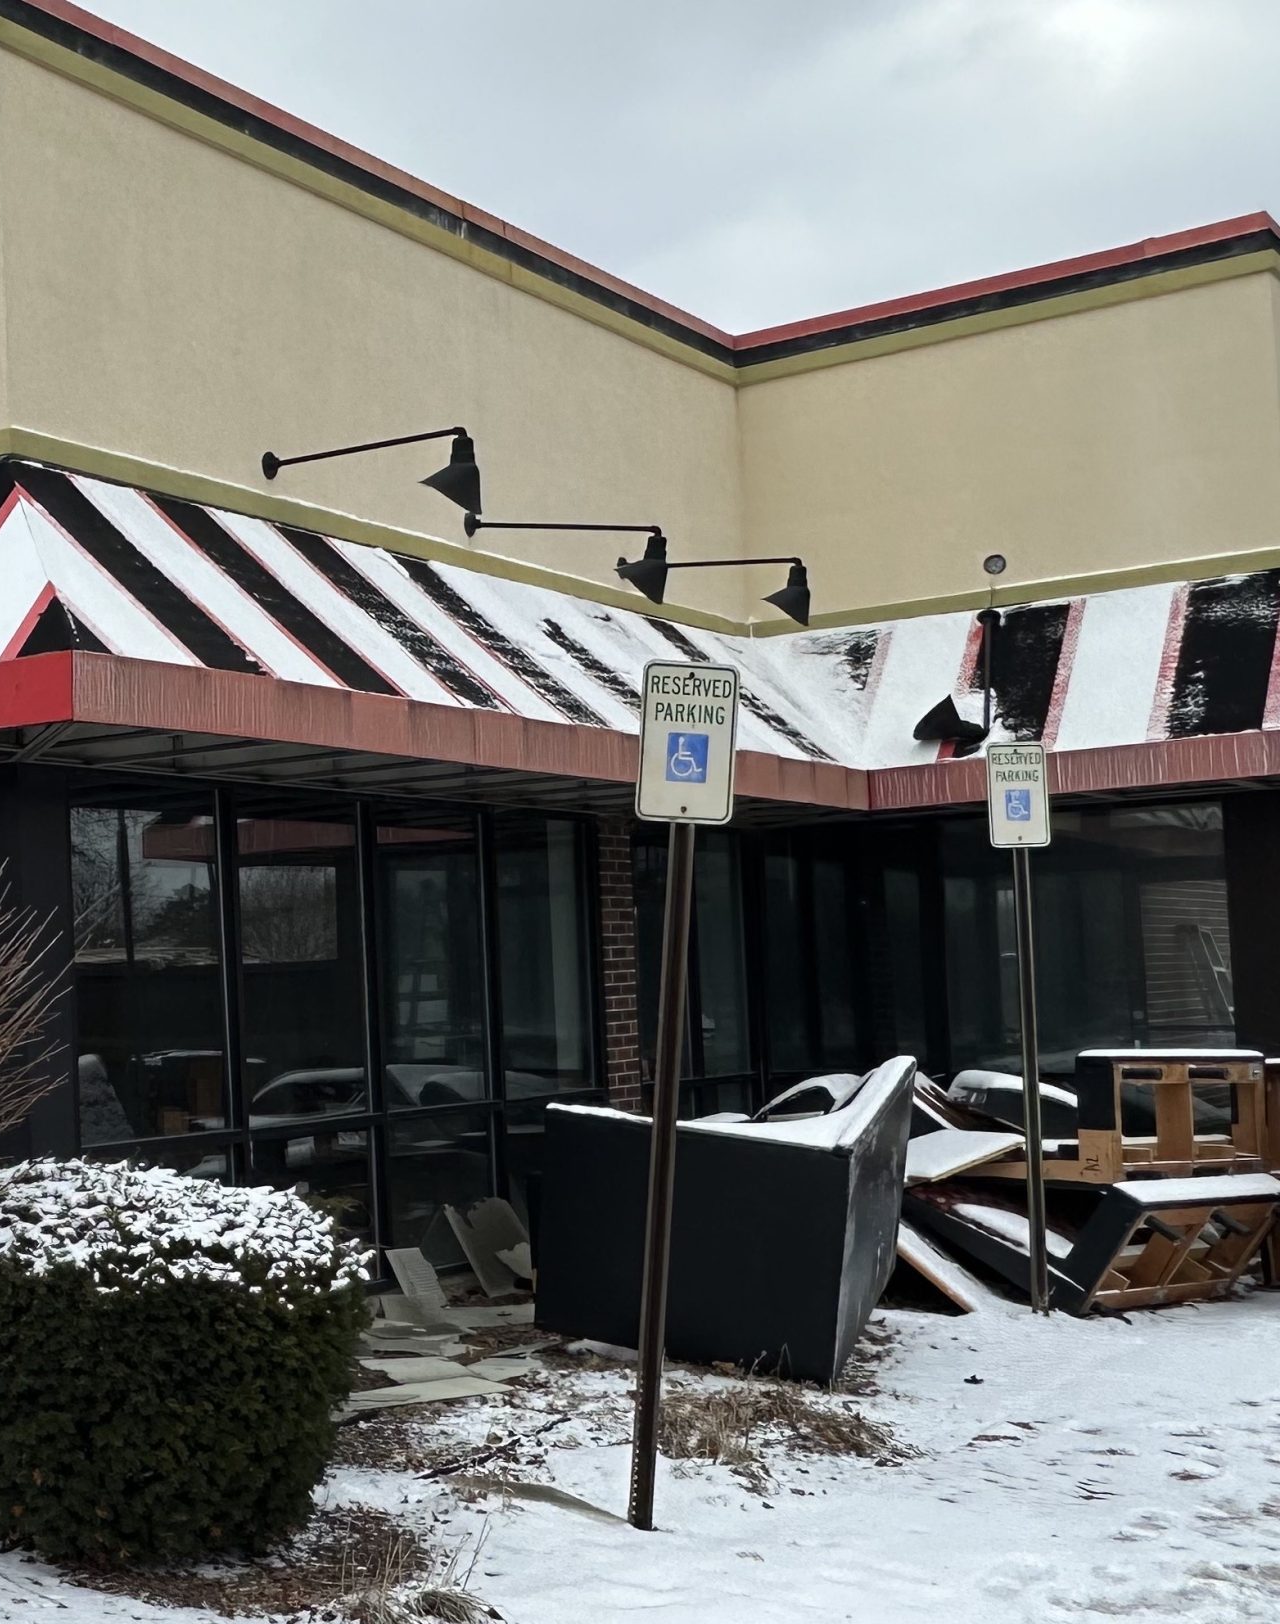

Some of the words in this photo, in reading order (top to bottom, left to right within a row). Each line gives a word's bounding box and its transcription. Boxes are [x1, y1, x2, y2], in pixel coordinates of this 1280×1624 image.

[651, 675, 732, 698] RESERVED
[654, 702, 725, 725] PARKING
[991, 752, 1041, 765] RESERVED
[995, 769, 1039, 782] PARKING
